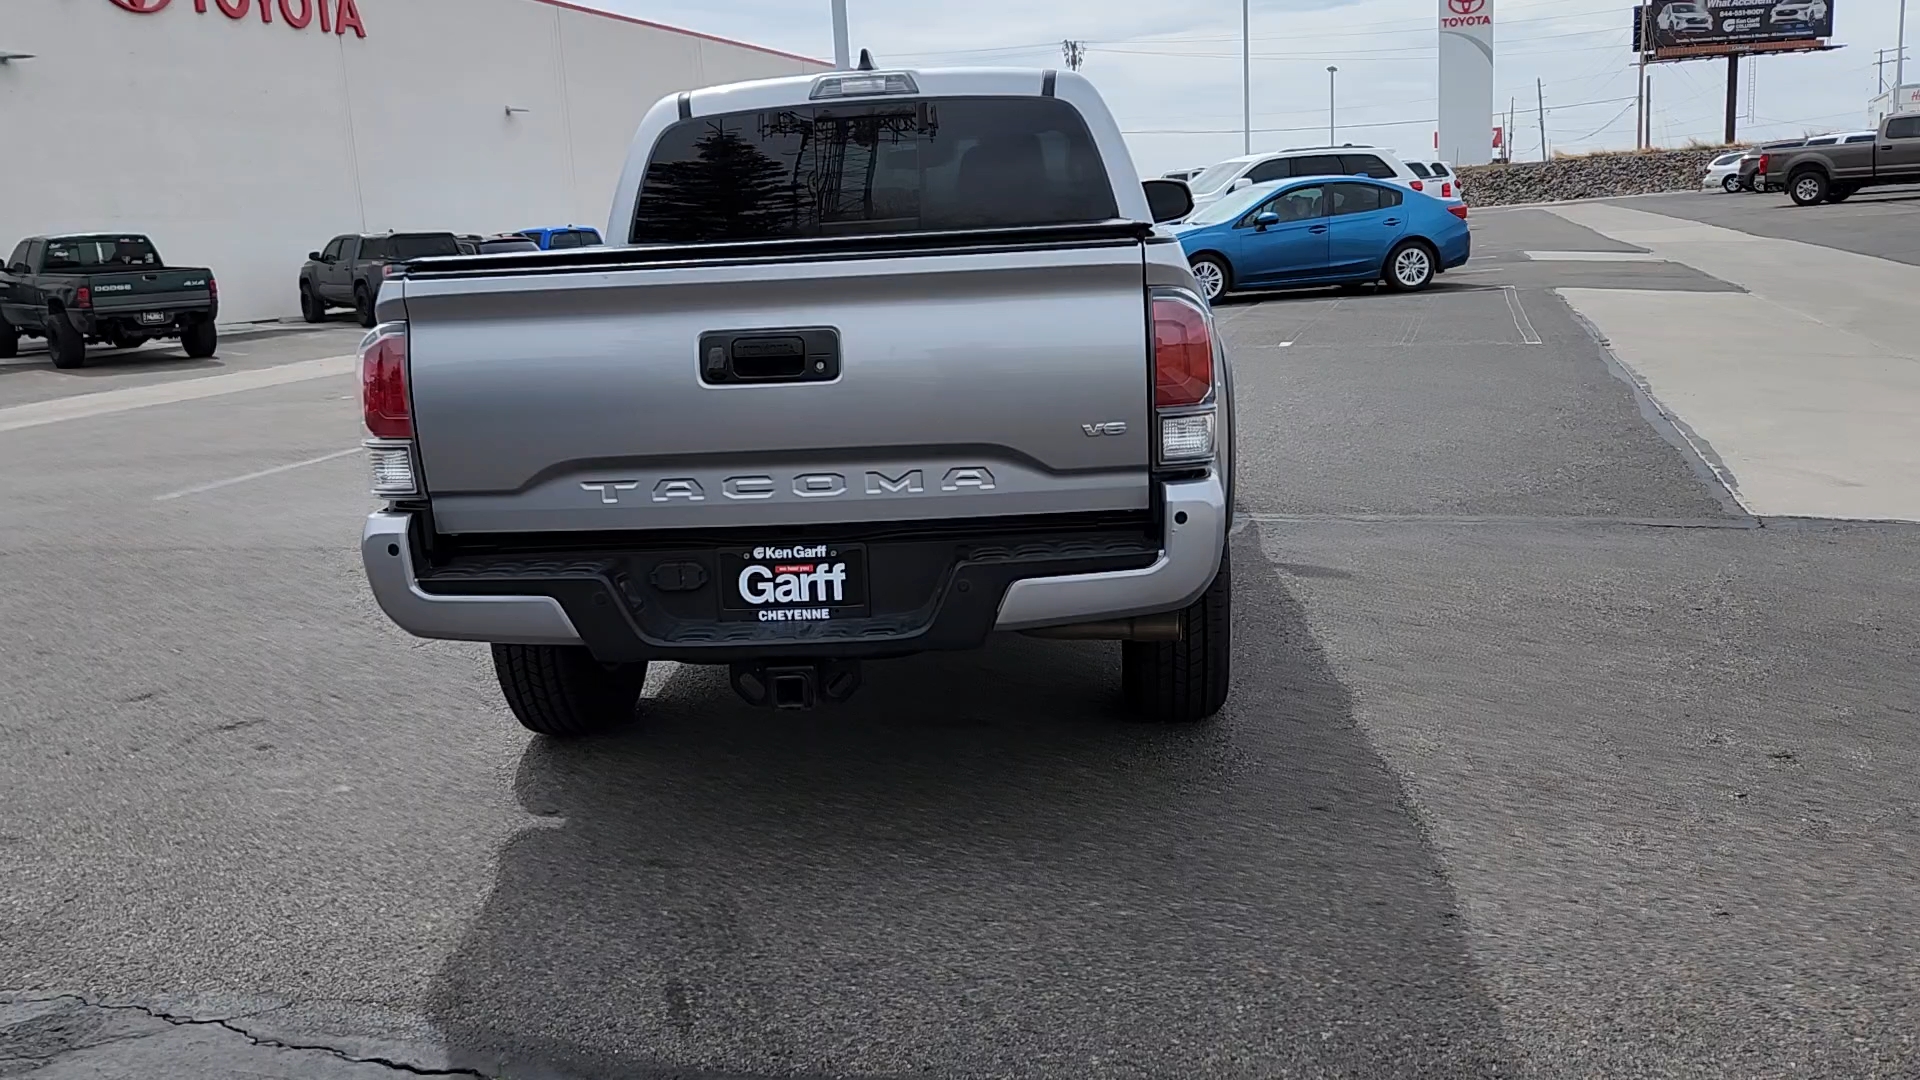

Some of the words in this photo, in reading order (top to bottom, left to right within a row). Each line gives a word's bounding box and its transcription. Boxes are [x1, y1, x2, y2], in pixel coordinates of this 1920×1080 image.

[1441, 15, 1491, 28] TOYOTA
[94, 284, 132, 292] DODGE
[1081, 421, 1127, 437] V6
[580, 466, 996, 504] TACOMA
[765, 546, 792, 559] Ken
[793, 545, 827, 558] Garff
[738, 563, 847, 604] Garff
[758, 608, 831, 621] CHEYENNE
